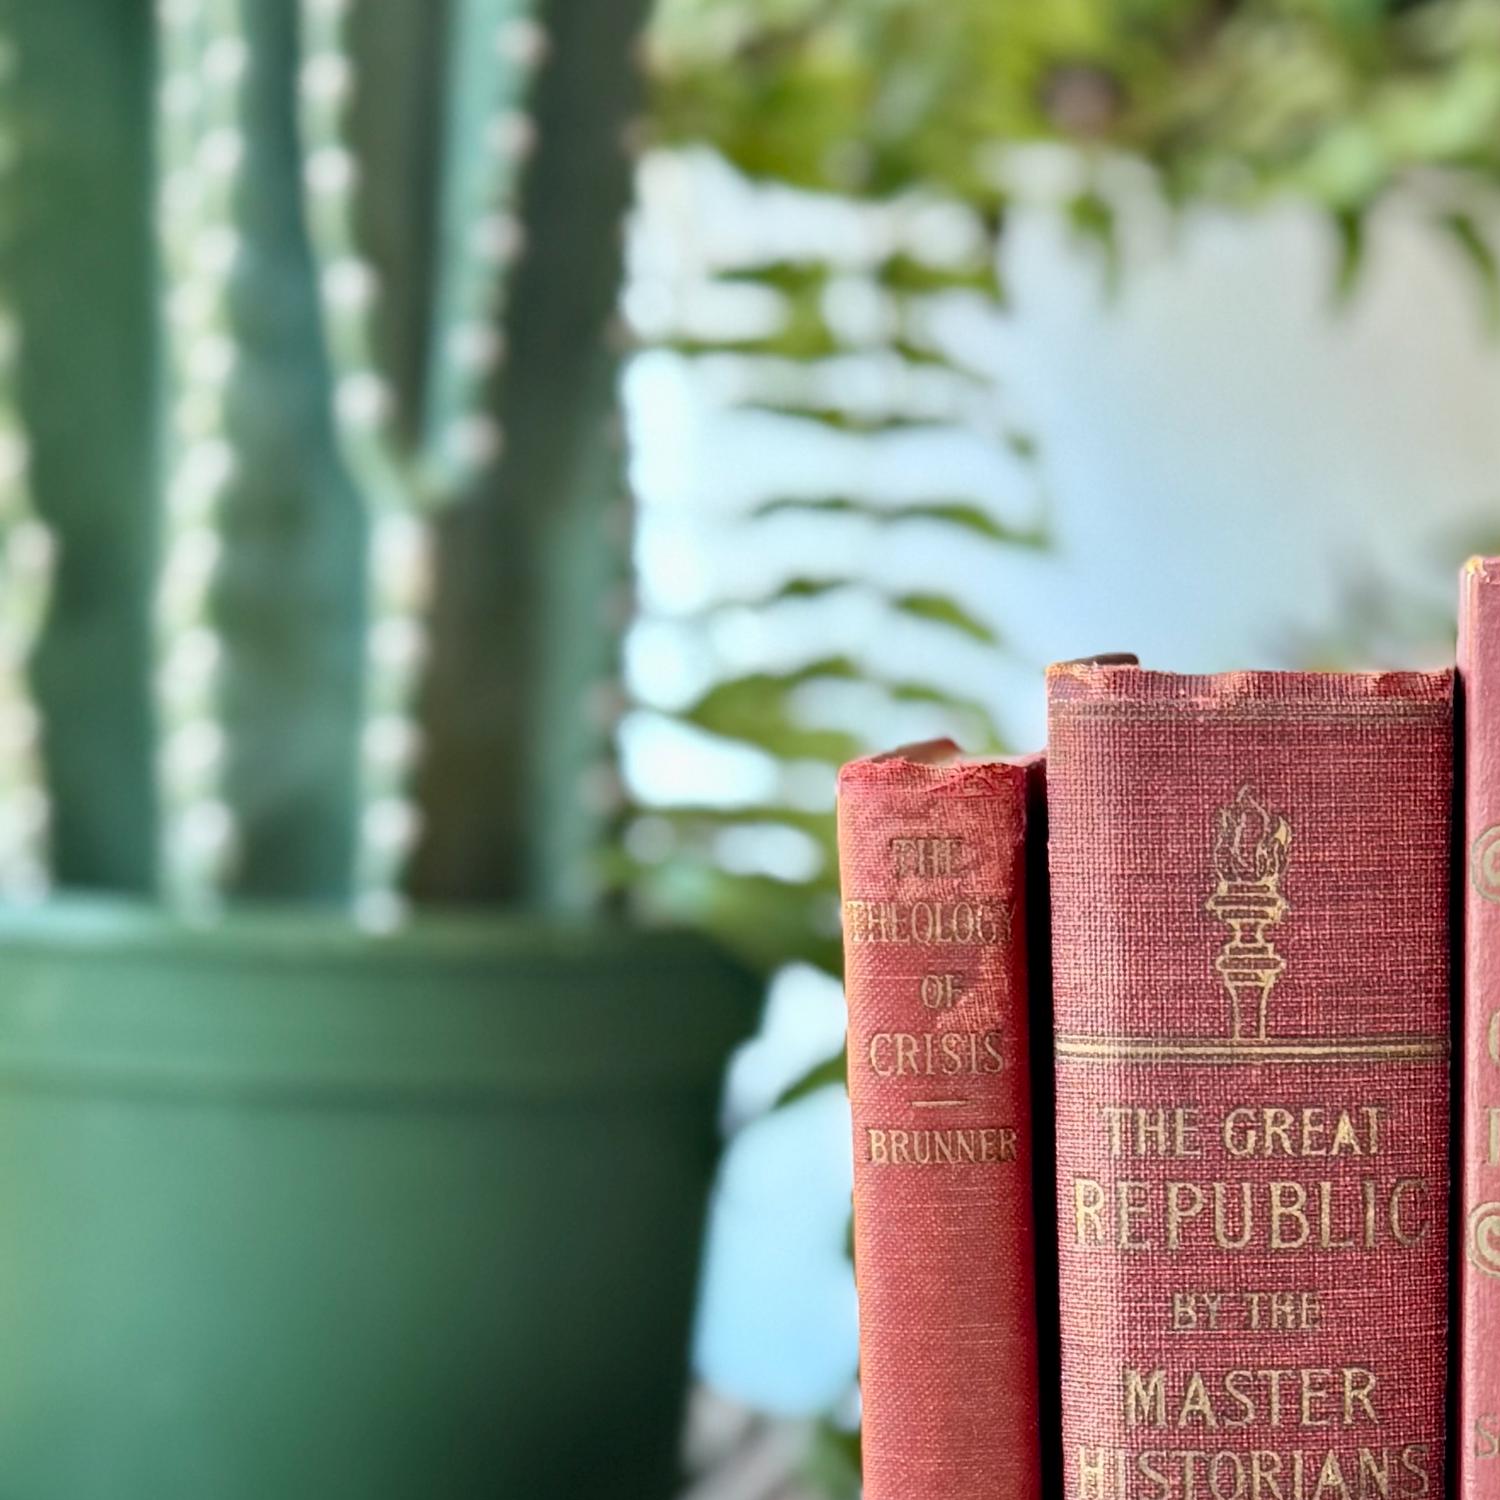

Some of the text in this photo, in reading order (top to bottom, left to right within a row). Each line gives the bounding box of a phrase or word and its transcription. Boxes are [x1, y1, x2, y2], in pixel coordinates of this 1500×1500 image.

[921, 974, 964, 1009] OF
[869, 1031, 1006, 1077] CRISIS
[866, 1128, 1018, 1165] BRUNNER
[1102, 1106, 1388, 1158] THE GREAT
[1073, 1177, 1430, 1251] REPUBLIC
[1172, 1291, 1321, 1331] BY THE
[1123, 1367, 1379, 1427] MASTER
